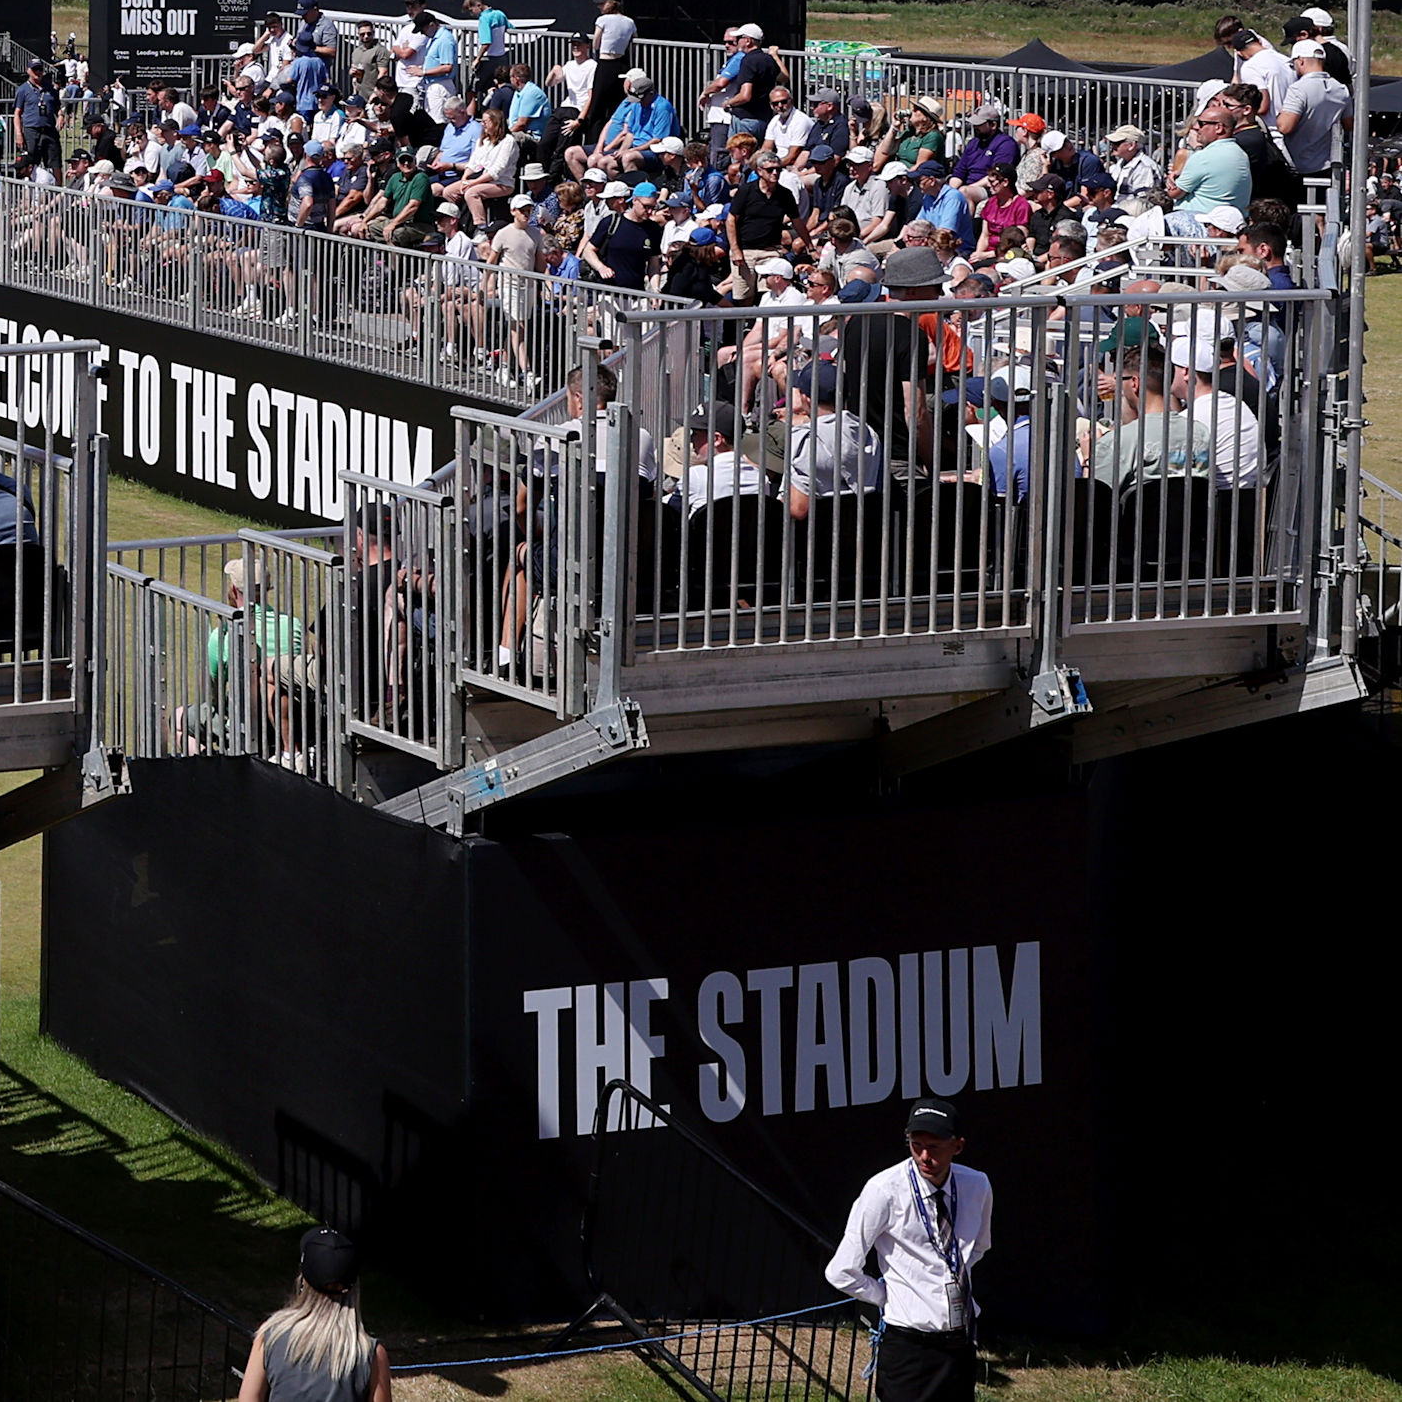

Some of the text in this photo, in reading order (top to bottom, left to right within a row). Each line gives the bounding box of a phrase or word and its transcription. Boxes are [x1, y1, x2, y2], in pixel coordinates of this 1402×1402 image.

[120, 9, 198, 36] MISS OUT
[118, 349, 160, 466] TO
[169, 362, 237, 490] THE
[246, 382, 434, 521] STADIUM
[523, 941, 1042, 1139] THE STADIUM
